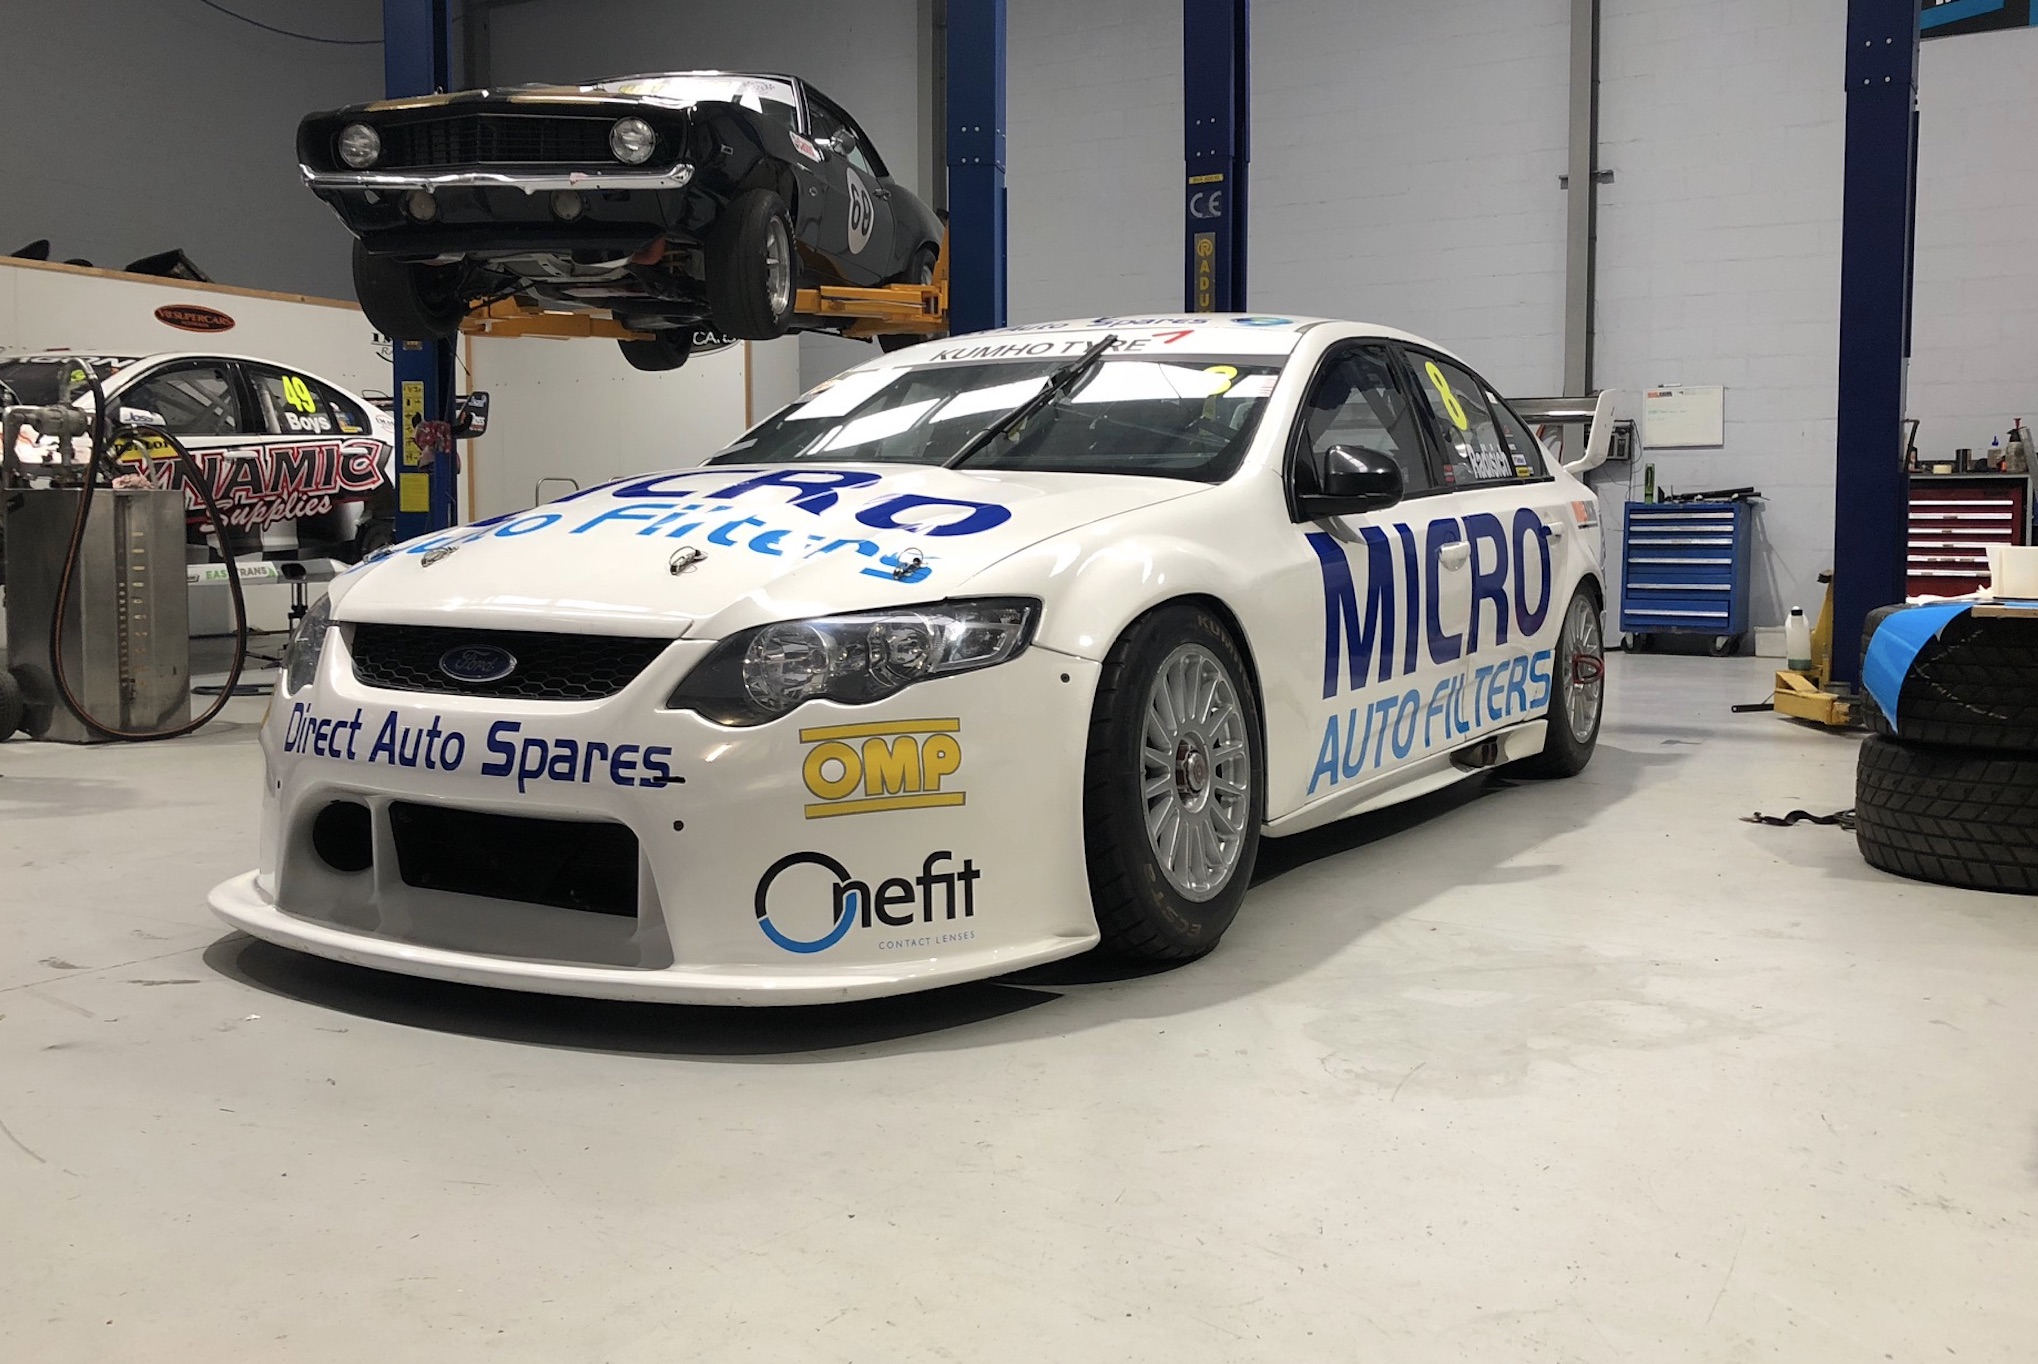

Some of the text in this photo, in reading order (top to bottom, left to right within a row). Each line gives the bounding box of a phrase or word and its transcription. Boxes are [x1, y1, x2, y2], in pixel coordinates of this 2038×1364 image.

[850, 182, 871, 237] 69
[1189, 190, 1222, 219] CE
[1086, 316, 1210, 330] Spares
[930, 338, 1152, 362] KUMHO TYRE
[281, 374, 317, 414] 49
[1424, 360, 1468, 431] 8
[284, 411, 332, 434] Boys
[199, 494, 333, 534] Supplies
[1304, 507, 1552, 700] MICRO
[453, 648, 498, 675] Ford
[1306, 649, 1552, 796] AUTO FILTERS
[283, 702, 674, 794] Direct Auto Spares
[801, 732, 963, 801] OMP
[753, 850, 981, 954] Onefit
[878, 930, 976, 951] CONTACT LENSES
